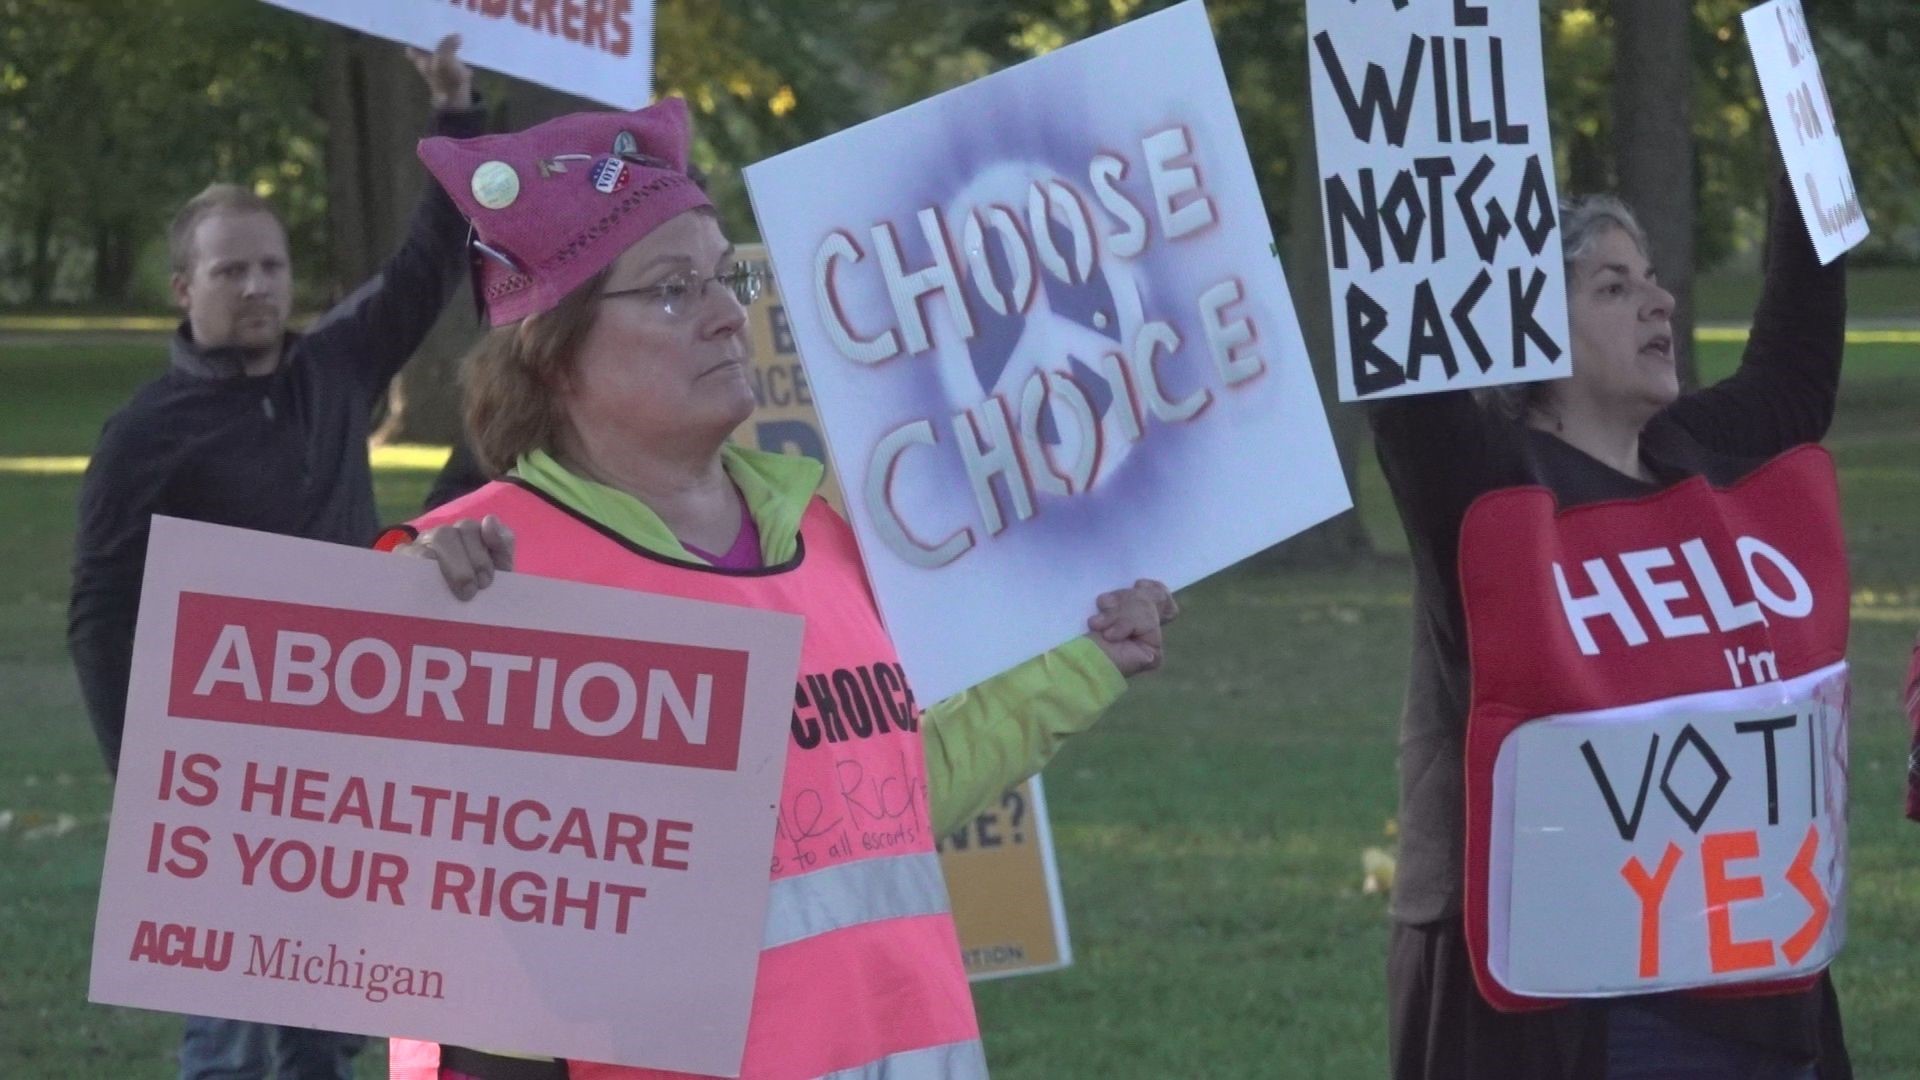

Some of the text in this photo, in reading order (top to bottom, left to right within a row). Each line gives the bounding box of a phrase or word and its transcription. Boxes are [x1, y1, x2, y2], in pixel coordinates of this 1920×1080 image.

[1313, 30, 1529, 147] WILL
[598, 159, 621, 188] VOTE
[1324, 154, 1556, 271] NOT GO
[814, 126, 1218, 366] CHOOSE
[1345, 267, 1562, 396] BACK
[865, 277, 1268, 568] CHOICE
[192, 624, 713, 745] ABORTION
[158, 750, 221, 806] IS
[240, 762, 694, 870] HEALTHCARE
[147, 822, 646, 934] IS YOUR RIGHT
[1620, 823, 1831, 978] YES
[129, 920, 446, 1002] ACLU Michigan
